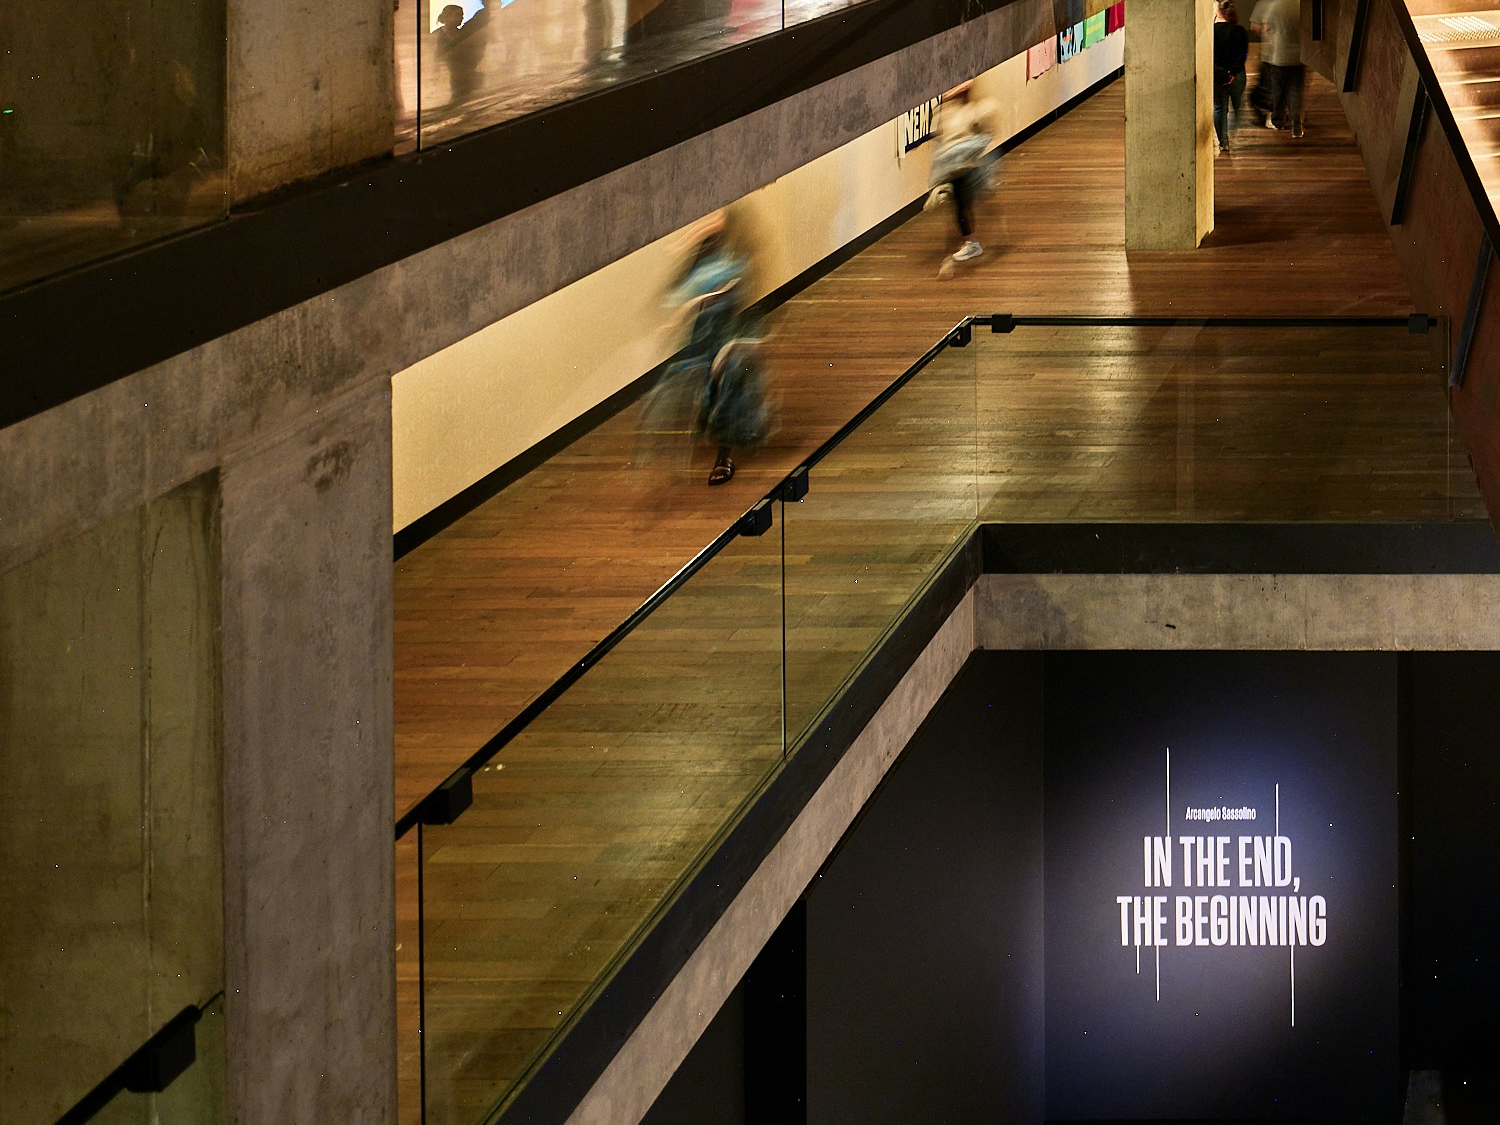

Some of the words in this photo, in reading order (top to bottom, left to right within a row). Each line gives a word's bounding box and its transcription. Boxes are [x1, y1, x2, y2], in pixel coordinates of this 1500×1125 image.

[1185, 806, 1221, 823] Arcangelo
[1221, 806, 1257, 821] Sassolino
[1144, 836, 1172, 888] IN
[1179, 836, 1231, 888] THE
[1238, 836, 1301, 893] END,
[1117, 896, 1168, 946] THE
[1175, 895, 1327, 947] BEGINNING
